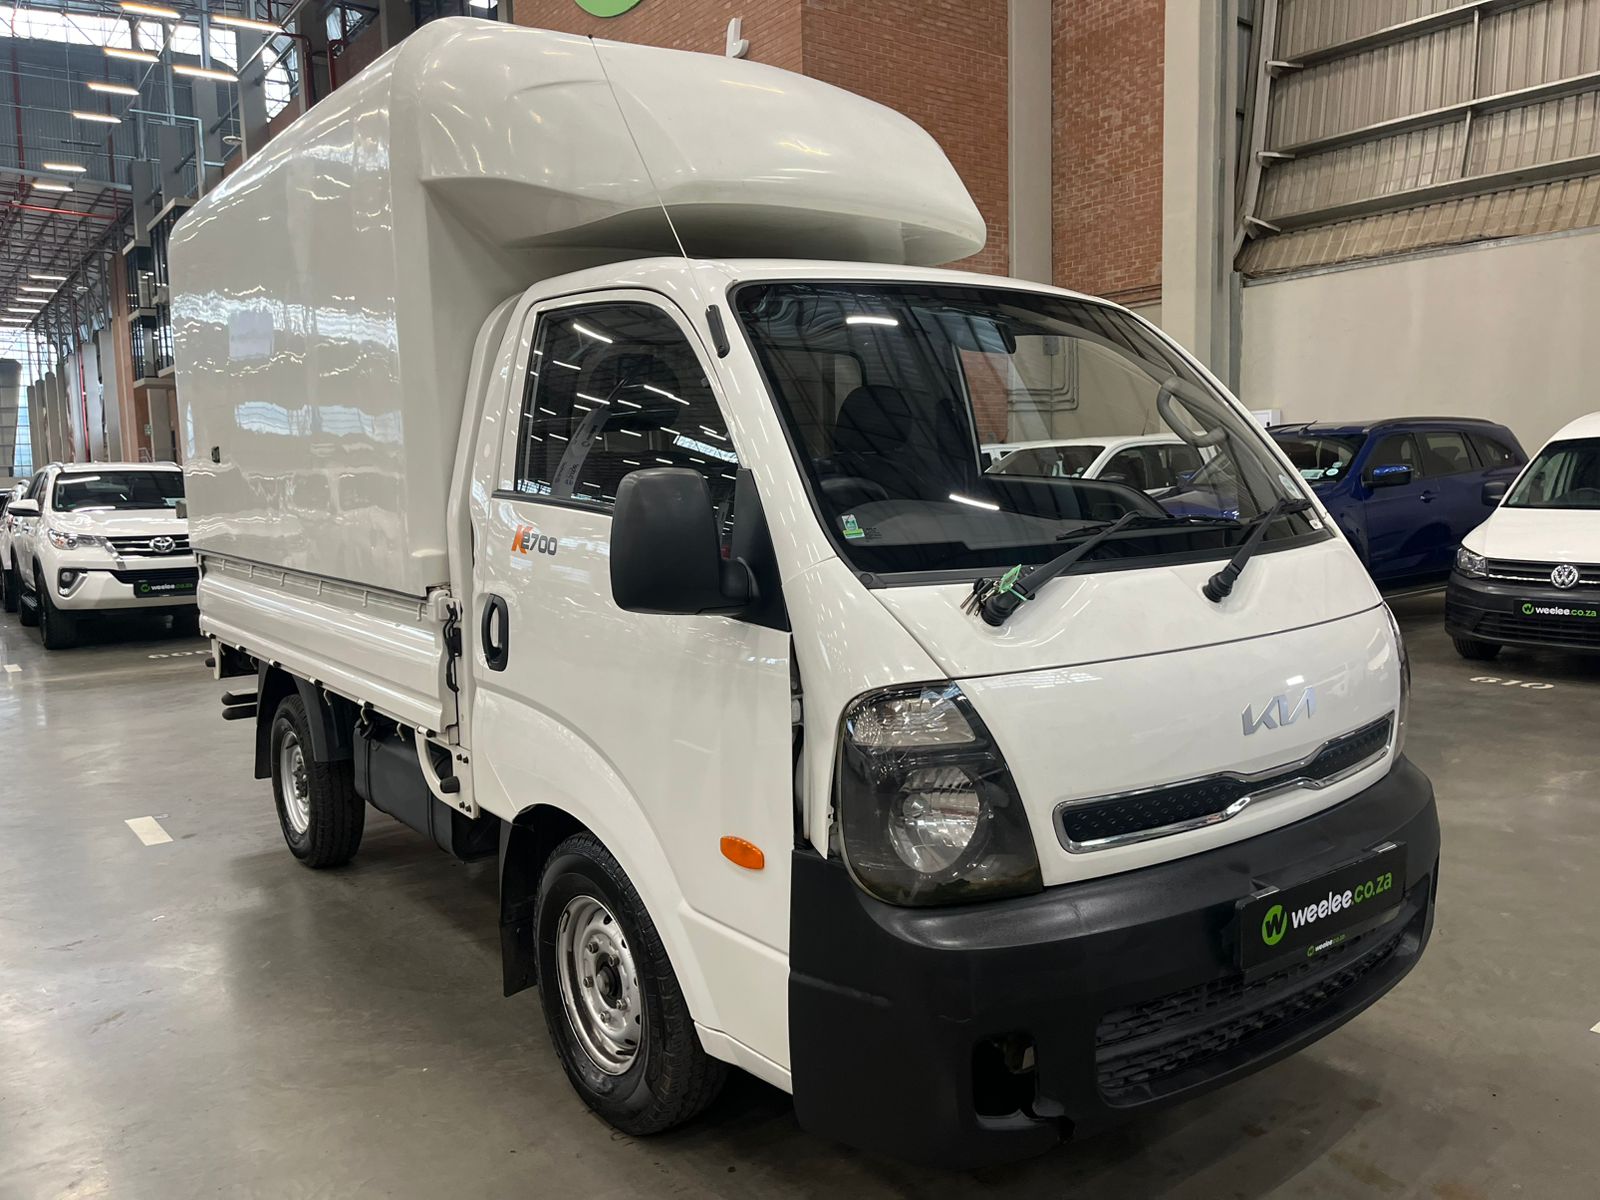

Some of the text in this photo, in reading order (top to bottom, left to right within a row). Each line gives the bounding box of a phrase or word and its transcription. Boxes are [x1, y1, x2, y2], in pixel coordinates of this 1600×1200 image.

[511, 524, 558, 556] K2700
[1535, 606, 1597, 617] weelee.co.za
[1241, 685, 1316, 736] KIA
[1292, 872, 1393, 929] weelee.co.za
